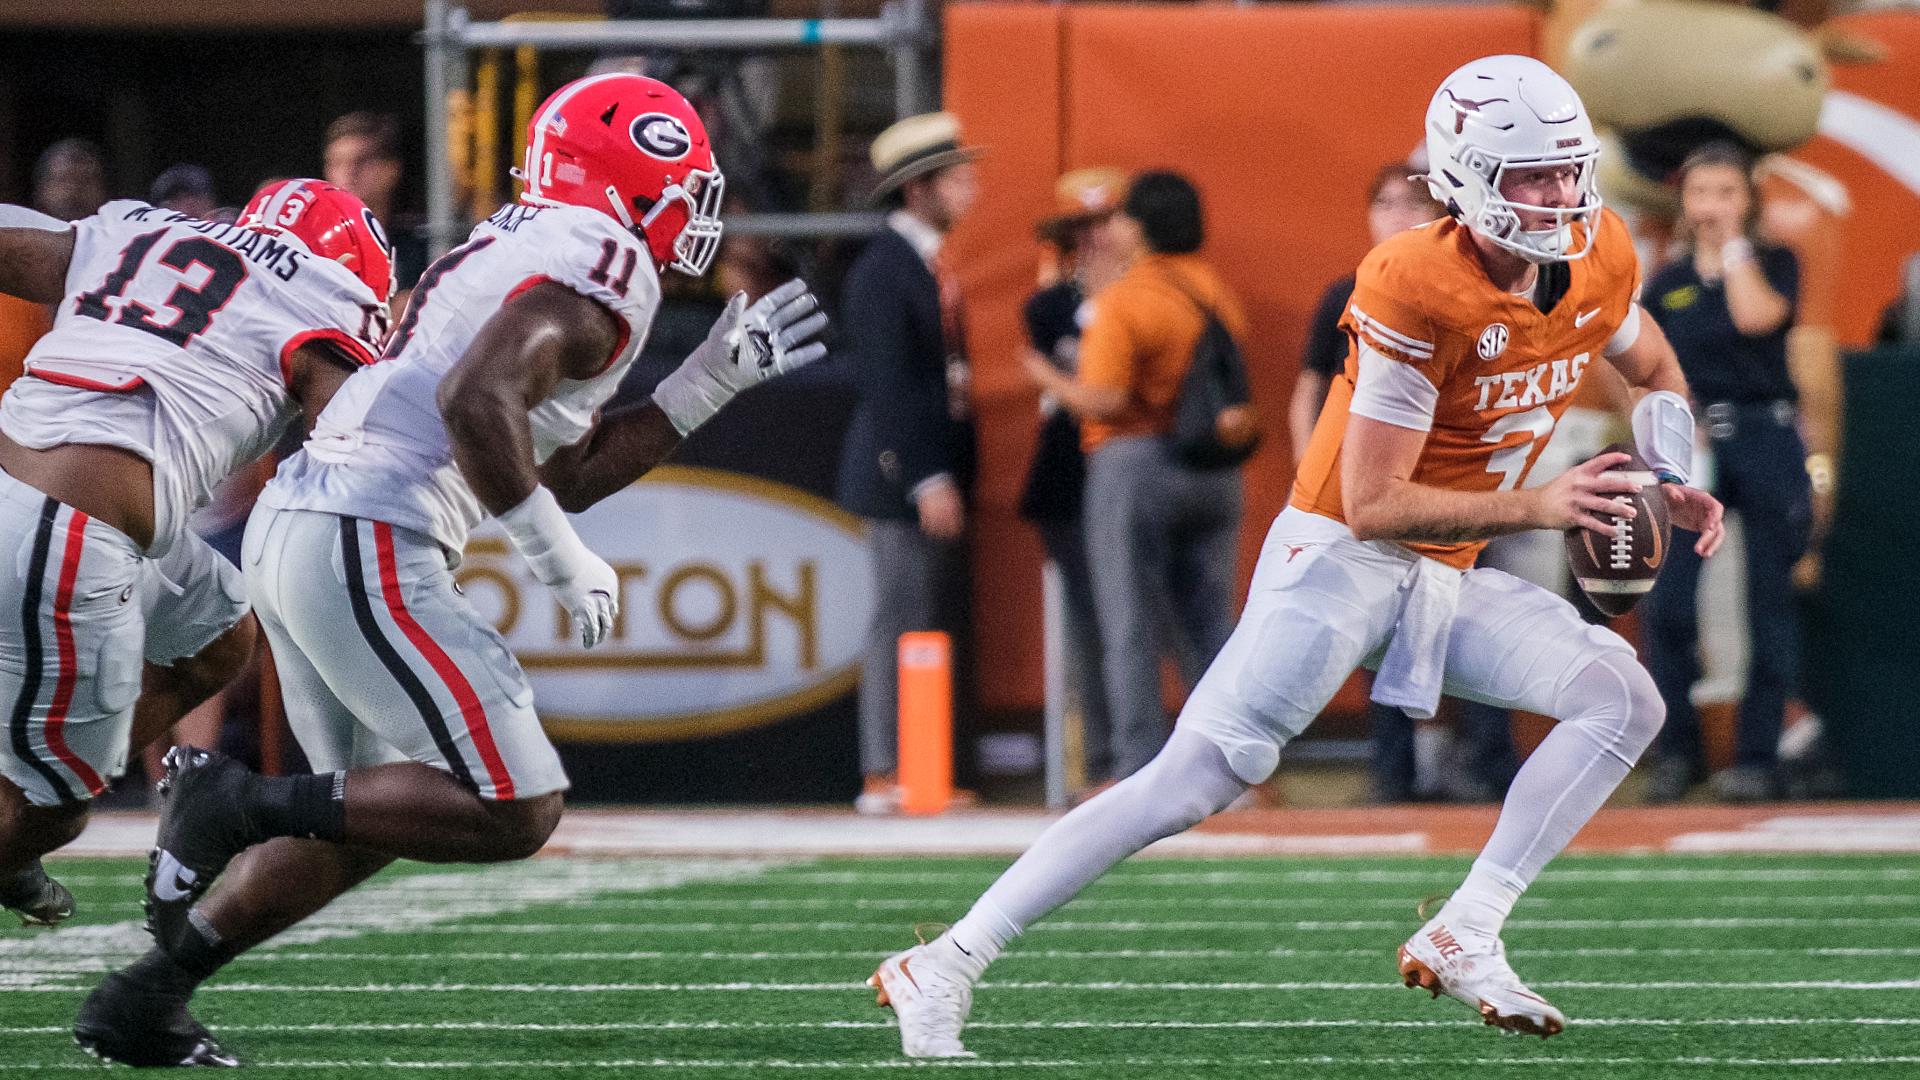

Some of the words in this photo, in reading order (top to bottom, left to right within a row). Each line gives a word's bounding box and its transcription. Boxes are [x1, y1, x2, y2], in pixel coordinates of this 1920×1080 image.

[74, 226, 249, 349] 13
[588, 237, 637, 300] 11
[1478, 324, 1509, 360] SEC
[1473, 352, 1590, 411] TEXAS
[1427, 924, 1463, 960] NIKE
